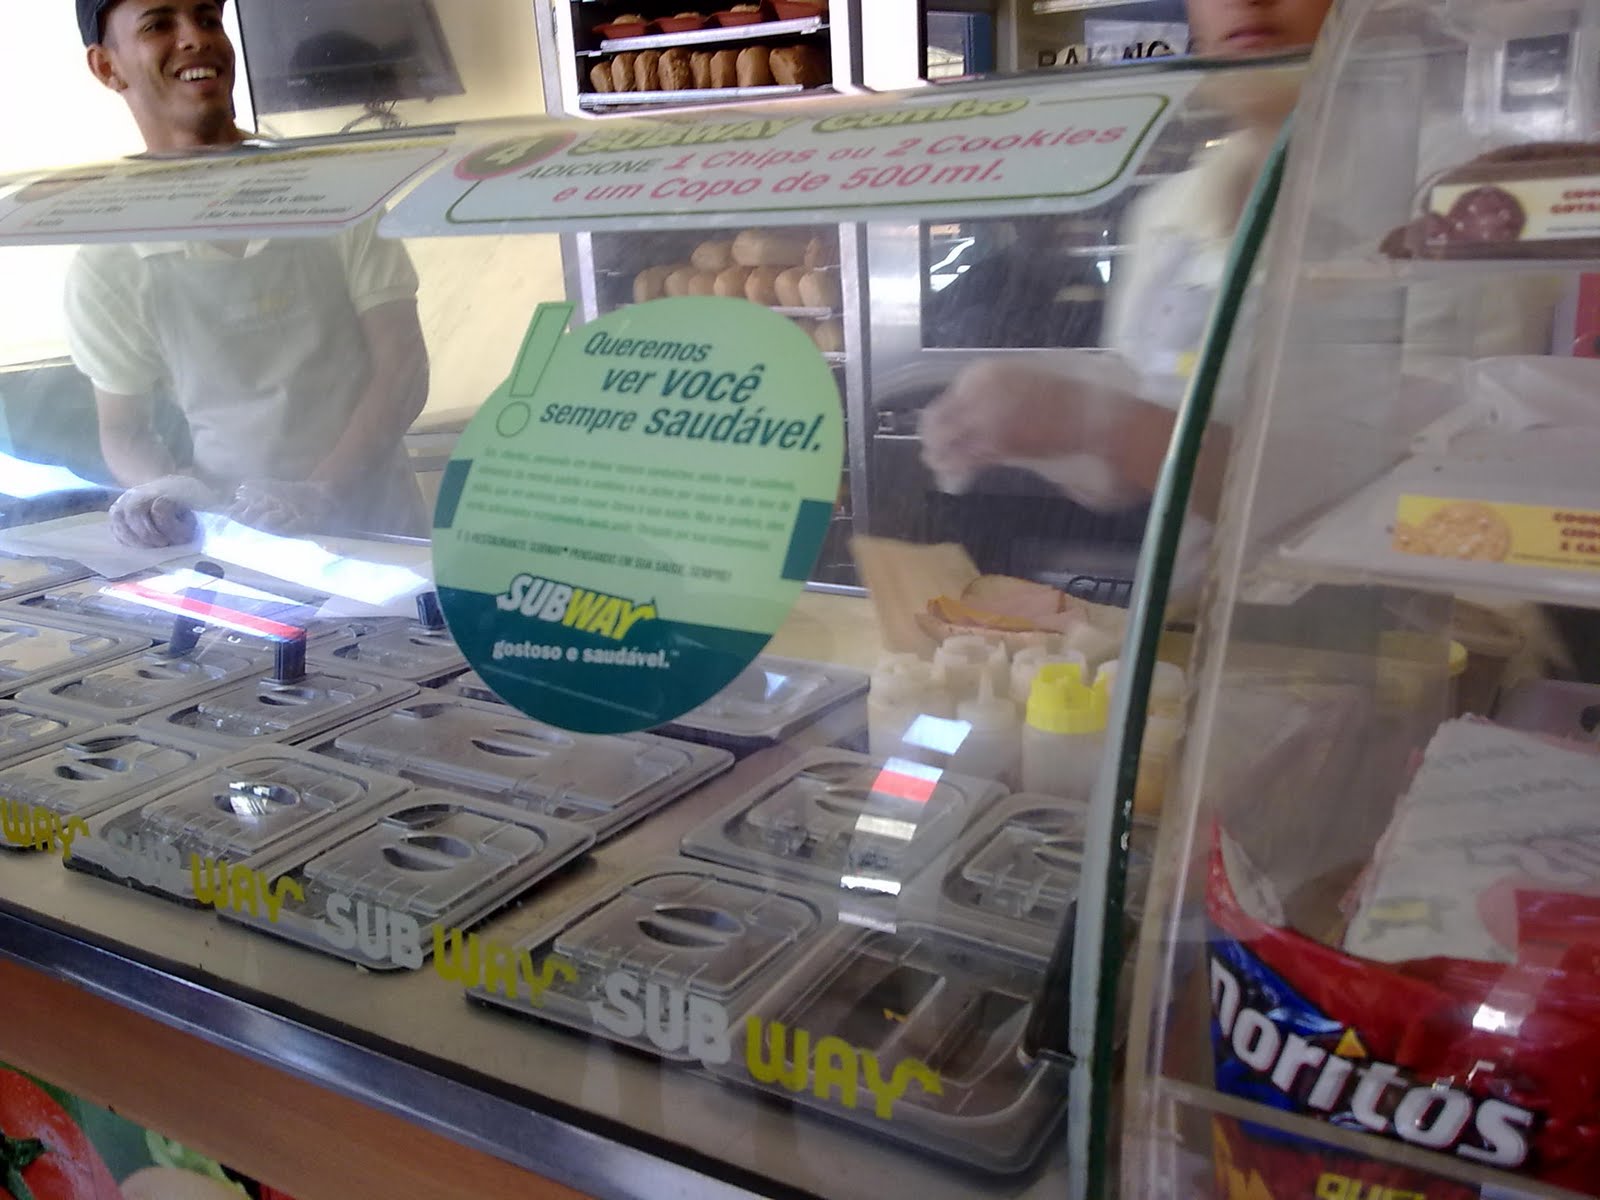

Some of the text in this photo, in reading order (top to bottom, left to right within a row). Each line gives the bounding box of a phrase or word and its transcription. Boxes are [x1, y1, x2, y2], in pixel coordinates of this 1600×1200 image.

[518, 126, 1127, 179] ADICIONE 1 Chips ou 2 Cookies
[552, 186, 578, 203] e
[585, 183, 645, 201] um
[650, 176, 762, 203] Copo
[771, 169, 831, 194] de
[583, 330, 713, 363] Queremos
[601, 363, 766, 404] ver você
[539, 402, 826, 453] sempre saudável.
[496, 573, 657, 641] SUBWAY
[492, 639, 563, 661] gostoso
[565, 646, 579, 662] e
